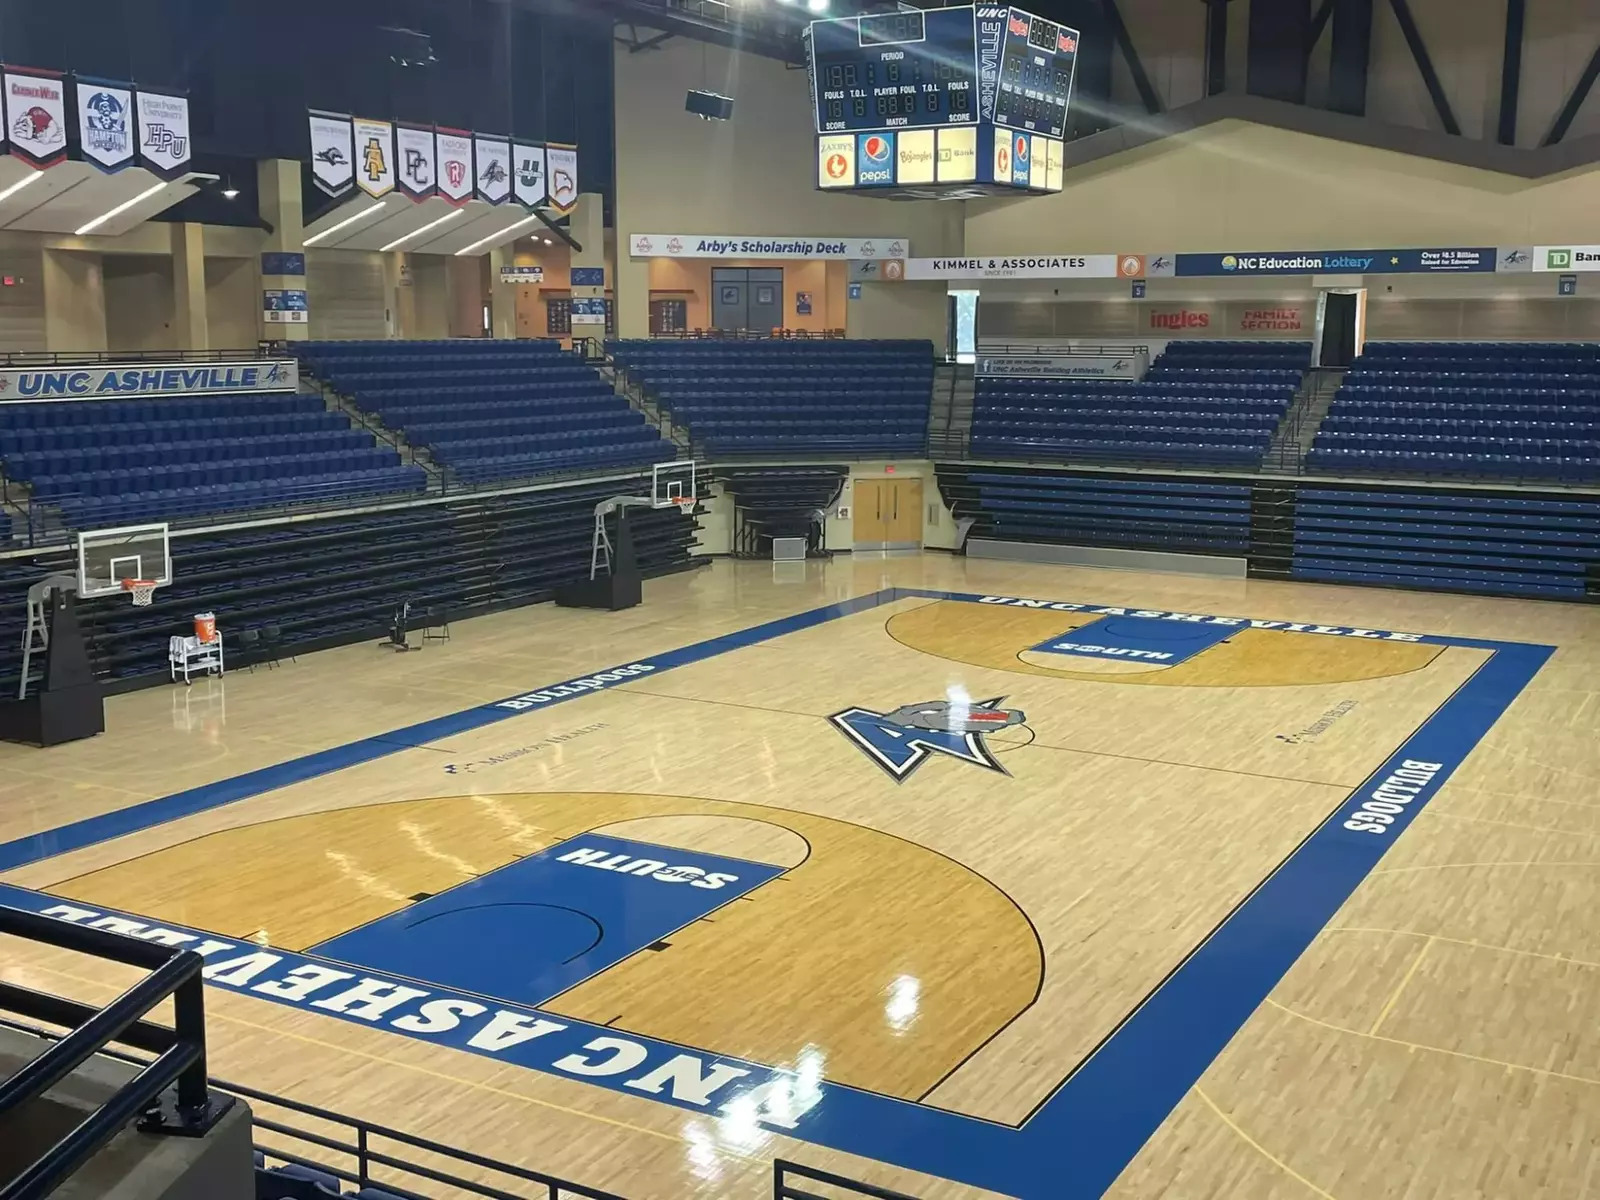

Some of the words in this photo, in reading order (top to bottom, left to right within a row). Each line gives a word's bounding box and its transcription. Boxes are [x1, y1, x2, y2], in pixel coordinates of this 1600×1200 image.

[976, 8, 1008, 18] UNC
[881, 51, 904, 60] PERIOD
[982, 22, 1001, 119] ASHEVILLE
[824, 91, 844, 99] FOULS
[874, 87, 898, 96] PLAYER
[900, 86, 917, 94] FOUL
[948, 81, 969, 90] FOULS
[886, 118, 908, 126] MATCH
[949, 113, 970, 122] SCORE
[826, 121, 846, 130] SCORE
[143, 123, 188, 160] HPU
[860, 169, 891, 183] pepsi
[696, 240, 738, 254] Arby's
[741, 240, 813, 256] Scholarship
[815, 242, 847, 255] Deck
[1421, 251, 1440, 259] Over
[933, 259, 983, 270] KIMMEL
[988, 259, 996, 269] &
[1001, 257, 1086, 269] ASSOCIATES
[1238, 257, 1256, 270] NC
[1259, 256, 1322, 270] Education
[1324, 256, 1374, 271] Lottery
[1550, 252, 1568, 266] TD
[1575, 252, 1600, 262] Ban
[1151, 310, 1209, 330] ingles
[1244, 310, 1297, 320] FAMILY
[1241, 320, 1301, 331] SECTION
[1010, 366, 1041, 374] Asheville
[1072, 367, 1104, 375] Athletics
[18, 371, 93, 396] UNC
[94, 367, 260, 393] ASHEVILLE
[978, 596, 1086, 612] UNC
[1090, 606, 1424, 642] ASHEVILLE
[1052, 642, 1174, 660] SOUTH
[496, 663, 656, 711] BULLDOGS
[1343, 758, 1443, 834] BULLDOGS
[556, 847, 739, 889] SOUTH
